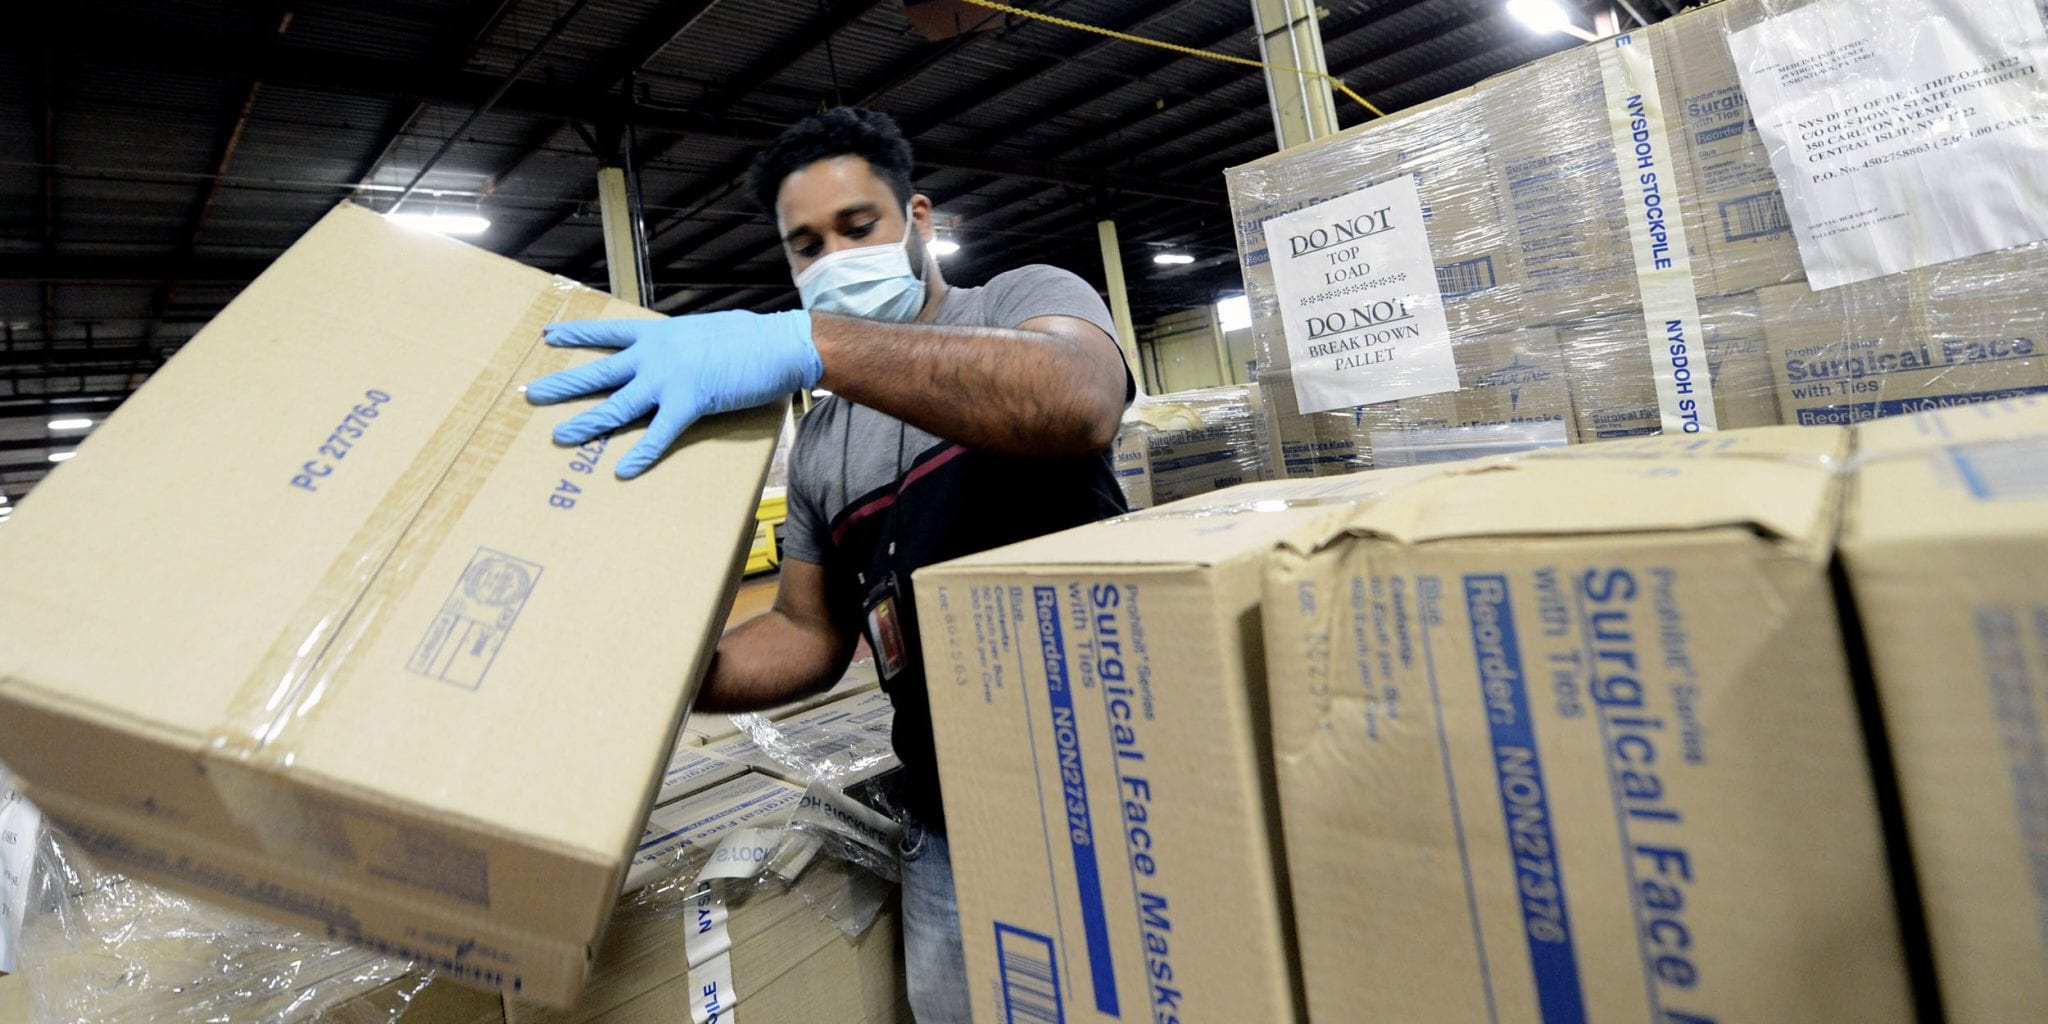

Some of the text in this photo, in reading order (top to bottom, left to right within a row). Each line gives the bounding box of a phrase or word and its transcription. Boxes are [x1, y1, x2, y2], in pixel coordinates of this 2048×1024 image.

[1798, 117, 1824, 130] NYS
[1863, 99, 1881, 110] OF
[1801, 128, 1824, 141] C/O
[1903, 91, 1950, 110] STATE
[1806, 140, 1825, 152] 350
[1808, 140, 1870, 163] CENTRAL
[1626, 94, 1672, 271] NYSDOH STOCKPILE
[1812, 168, 1838, 184] P.O.
[1290, 206, 1395, 256] DO NOT
[1325, 262, 1371, 285] LOAD
[1326, 246, 1361, 266] TOP
[1305, 312, 1346, 338] DO
[1308, 323, 1420, 359] BREAK DOWN
[1334, 347, 1396, 371] PALLET
[1665, 319, 1700, 434] NYSDOH STO
[1787, 336, 2034, 382] Surgical Face
[1792, 379, 1879, 400] with Ties
[1801, 407, 1888, 425] Reorder:
[289, 388, 391, 493] PC 27376-0
[548, 477, 583, 511] AB
[1068, 582, 1096, 689] with Ties
[1532, 566, 1586, 719] with Ties
[1036, 588, 1090, 847] Reorder: NON27376
[1093, 583, 1145, 761] Surgical
[1122, 774, 1157, 876] Face
[1467, 578, 1566, 945] Reorder: NON27376
[1584, 567, 1685, 824] Surgical
[1635, 844, 1699, 989] Face
